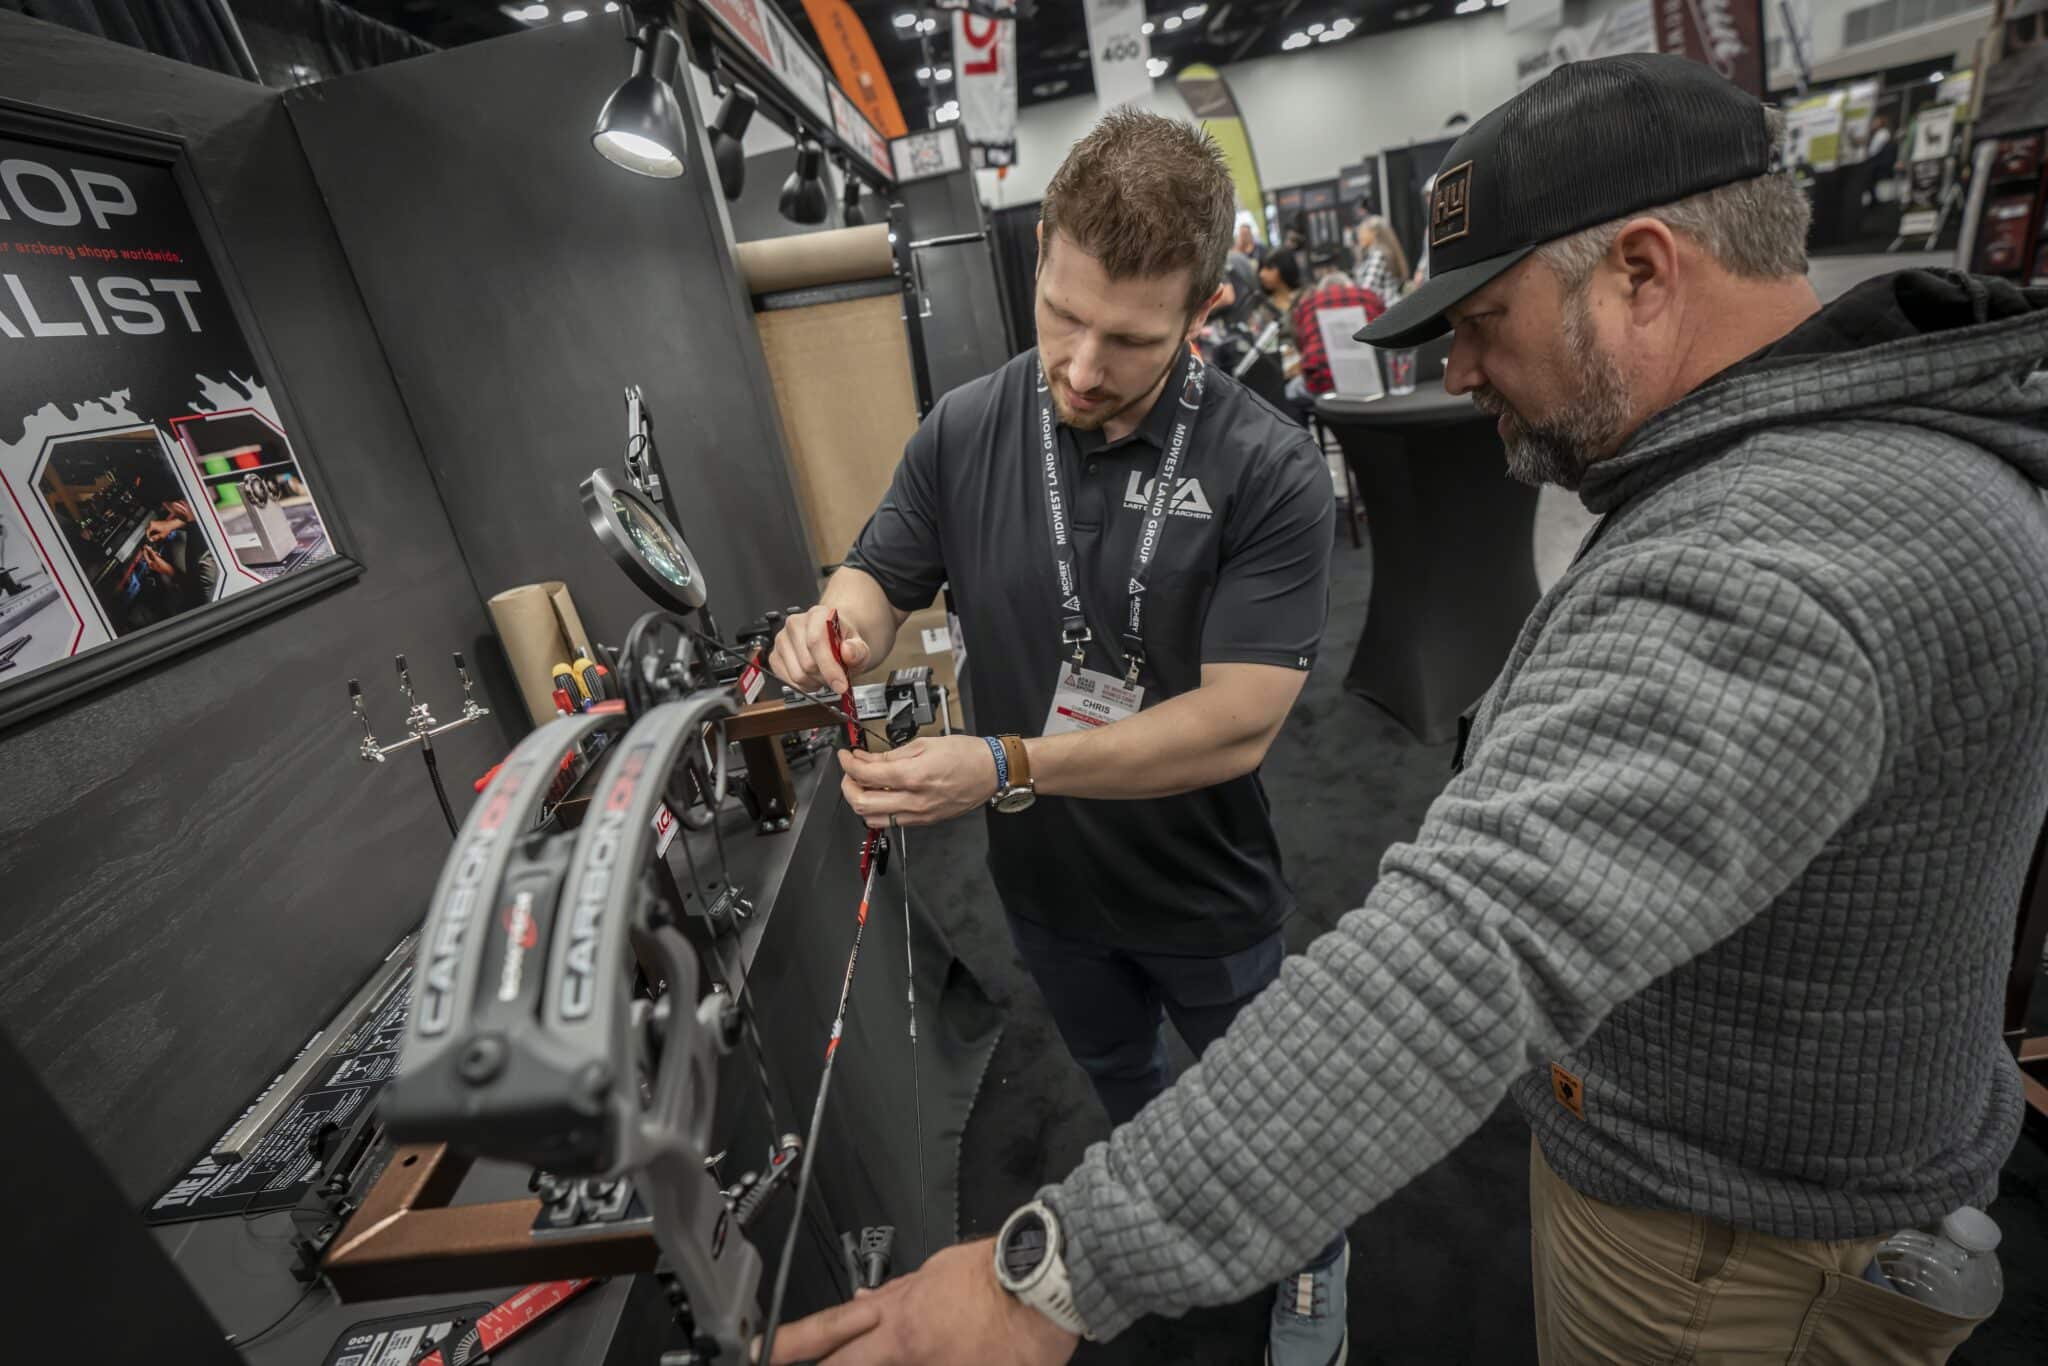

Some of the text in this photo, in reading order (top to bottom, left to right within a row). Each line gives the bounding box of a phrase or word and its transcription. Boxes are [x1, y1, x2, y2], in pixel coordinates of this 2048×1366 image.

[1103, 41, 1140, 62] 400
[0, 158, 138, 230] OP
[16, 241, 76, 260] archery
[77, 244, 118, 262] shops
[1162, 423, 1186, 480] MIDWEST
[1042, 408, 1066, 545] MIDWEST LAND GROUP
[1152, 482, 1169, 516] LAND
[1174, 510, 1212, 520] ARCHERY
[1140, 520, 1158, 563] GROUP
[1058, 560, 1071, 597] ARCHERY
[1082, 699, 1112, 714] CHRIS
[418, 827, 498, 1037] CARBON
[560, 808, 625, 1022] CARBON
